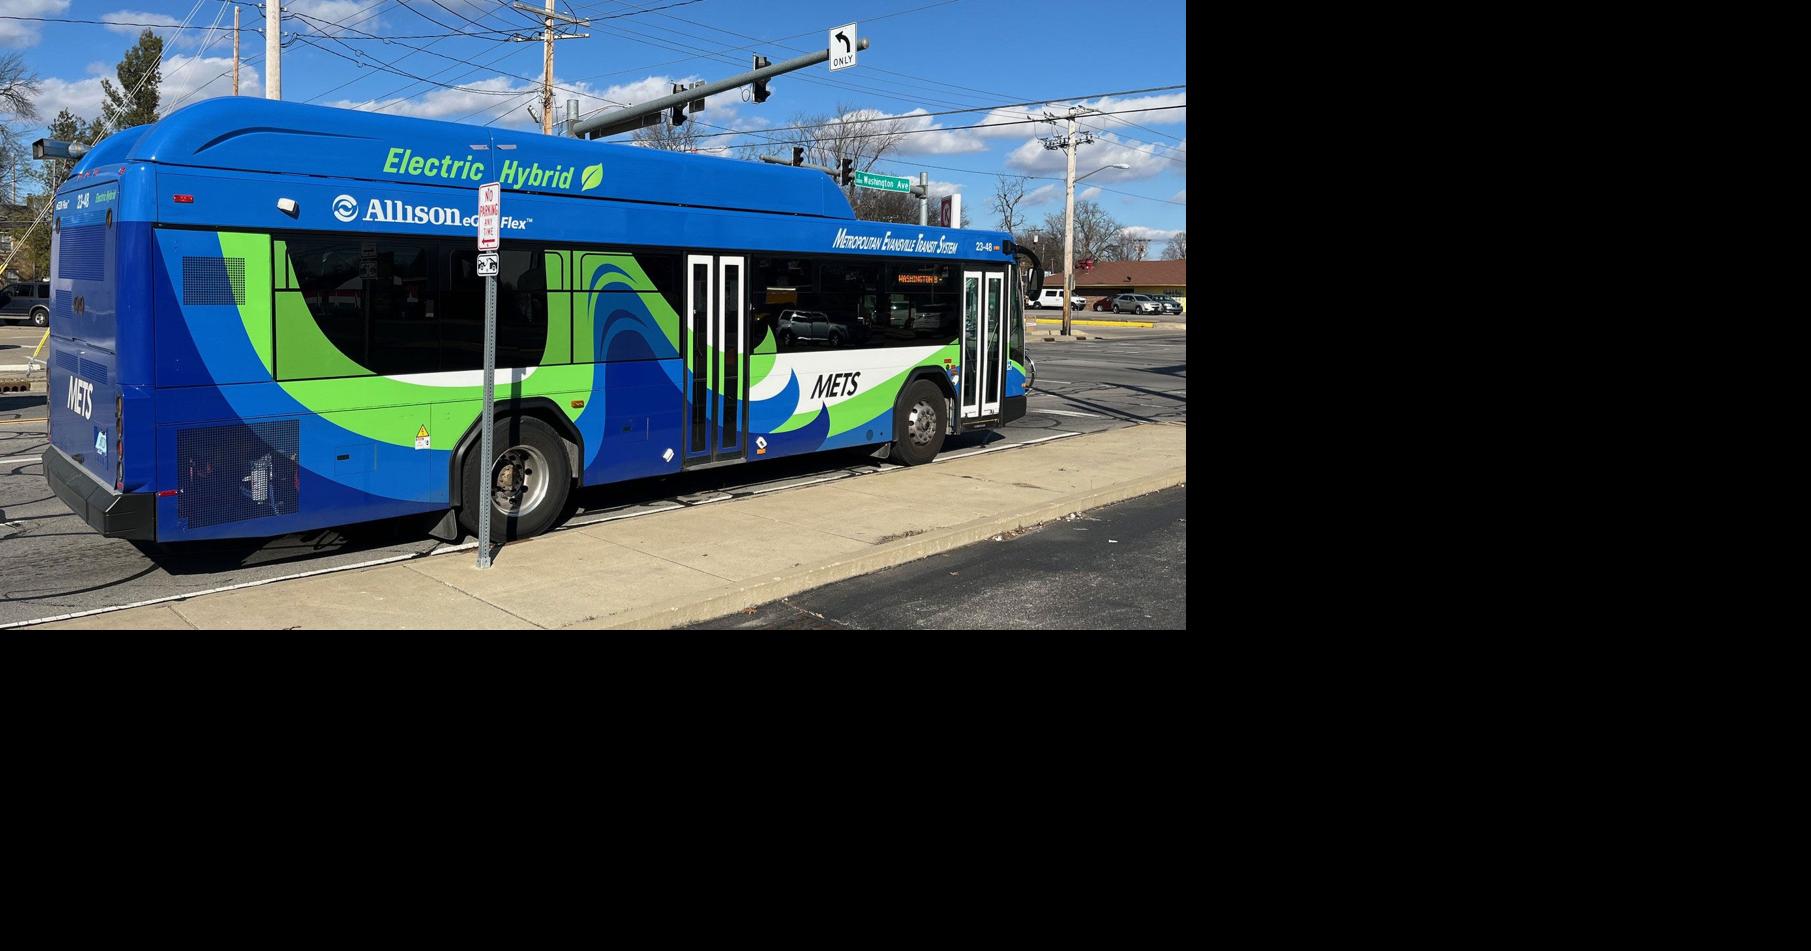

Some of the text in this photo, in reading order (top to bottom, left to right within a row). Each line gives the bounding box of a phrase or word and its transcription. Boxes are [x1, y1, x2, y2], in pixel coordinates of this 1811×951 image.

[833, 55, 853, 66] ONLY
[383, 147, 575, 190] Electric Hybrid
[863, 176, 894, 189] Washington
[897, 181, 909, 190] Ave
[484, 189, 494, 202] NO
[362, 198, 462, 227] Allison
[480, 203, 498, 217] PARKING
[484, 218, 493, 226] ANY
[483, 227, 494, 236] TIME
[975, 241, 993, 252] 23-48
[898, 273, 934, 284] WASHINGTON
[810, 371, 861, 400] METS
[67, 375, 94, 421] METS
